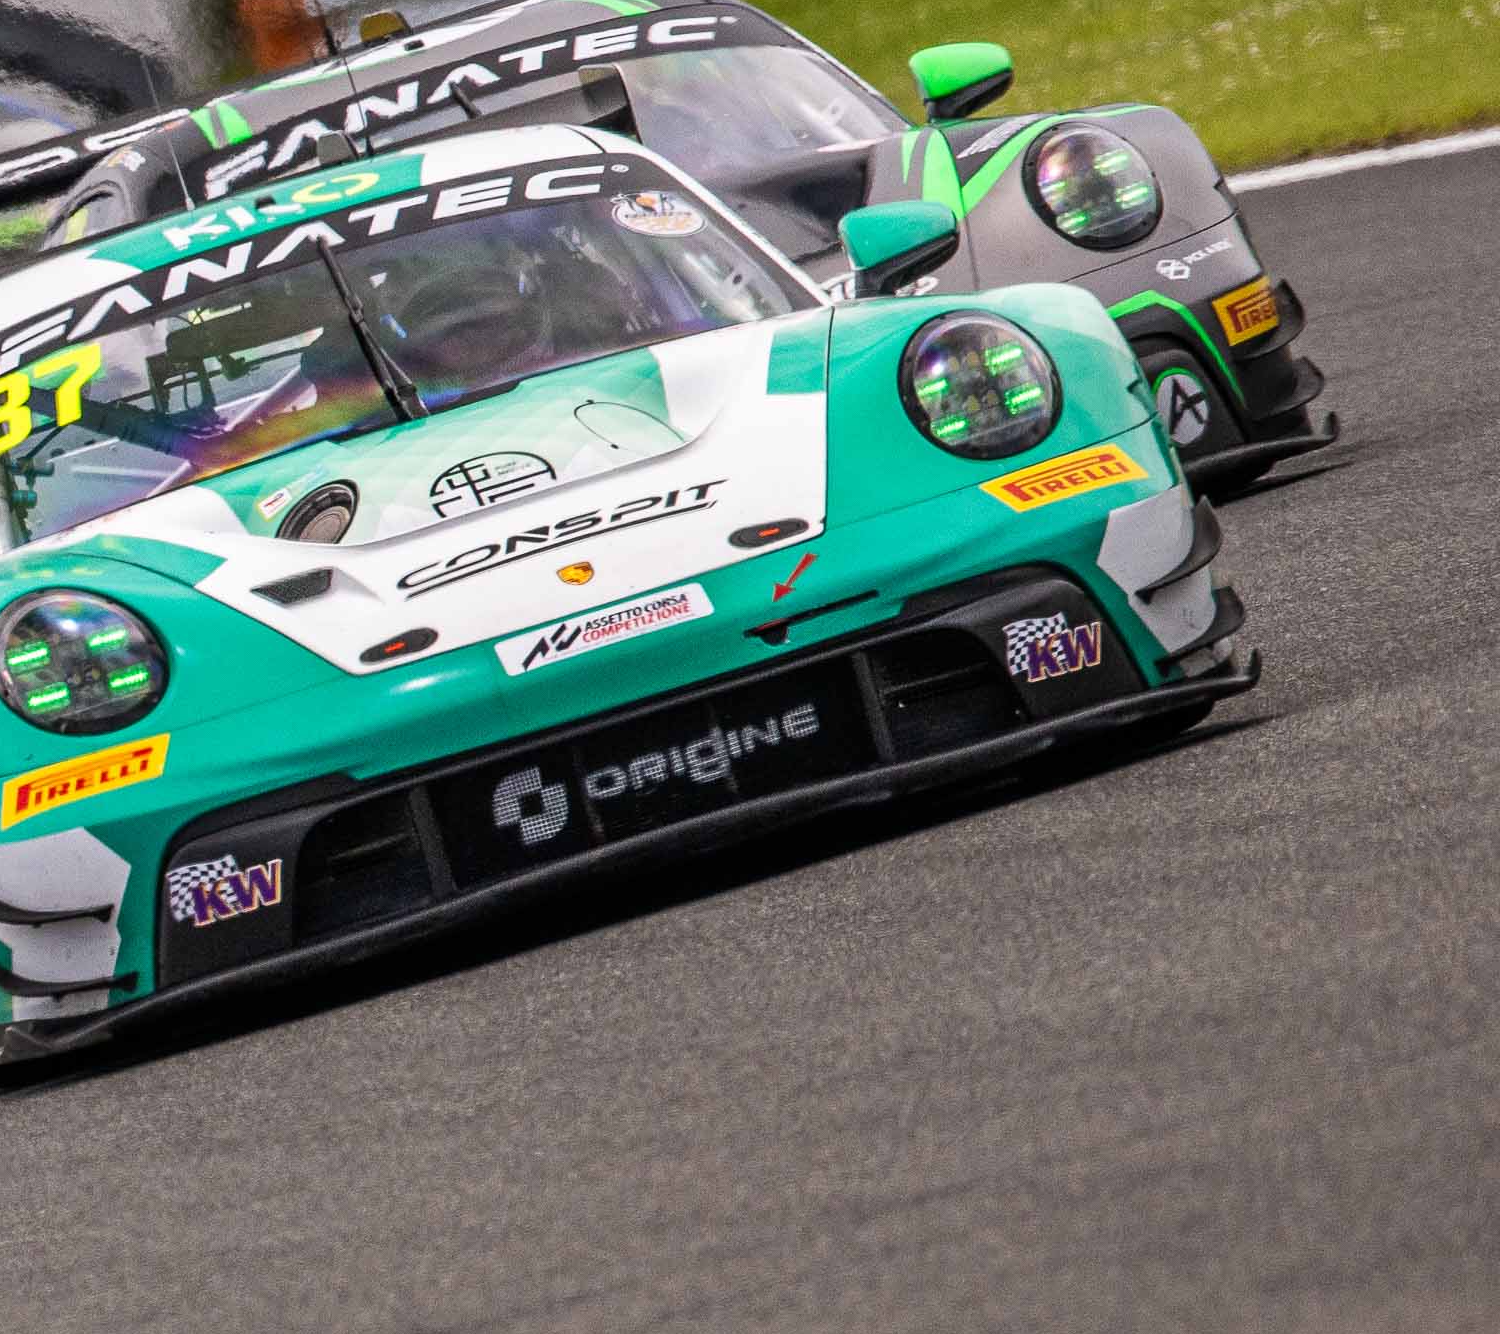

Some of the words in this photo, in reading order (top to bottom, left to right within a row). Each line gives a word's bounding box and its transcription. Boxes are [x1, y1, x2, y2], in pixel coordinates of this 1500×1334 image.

[204, 15, 714, 200] FANATEC
[0, 164, 606, 375] FANATEC
[1000, 453, 1130, 502] PIRELLI
[397, 479, 728, 589] CONSPIT
[582, 602, 690, 643] COMPETIZIONE
[584, 606, 643, 632] ASSETTO
[644, 593, 688, 614] CORSA
[1027, 621, 1102, 682] KW
[15, 747, 153, 815] PIRELLI
[192, 858, 282, 927] KW
